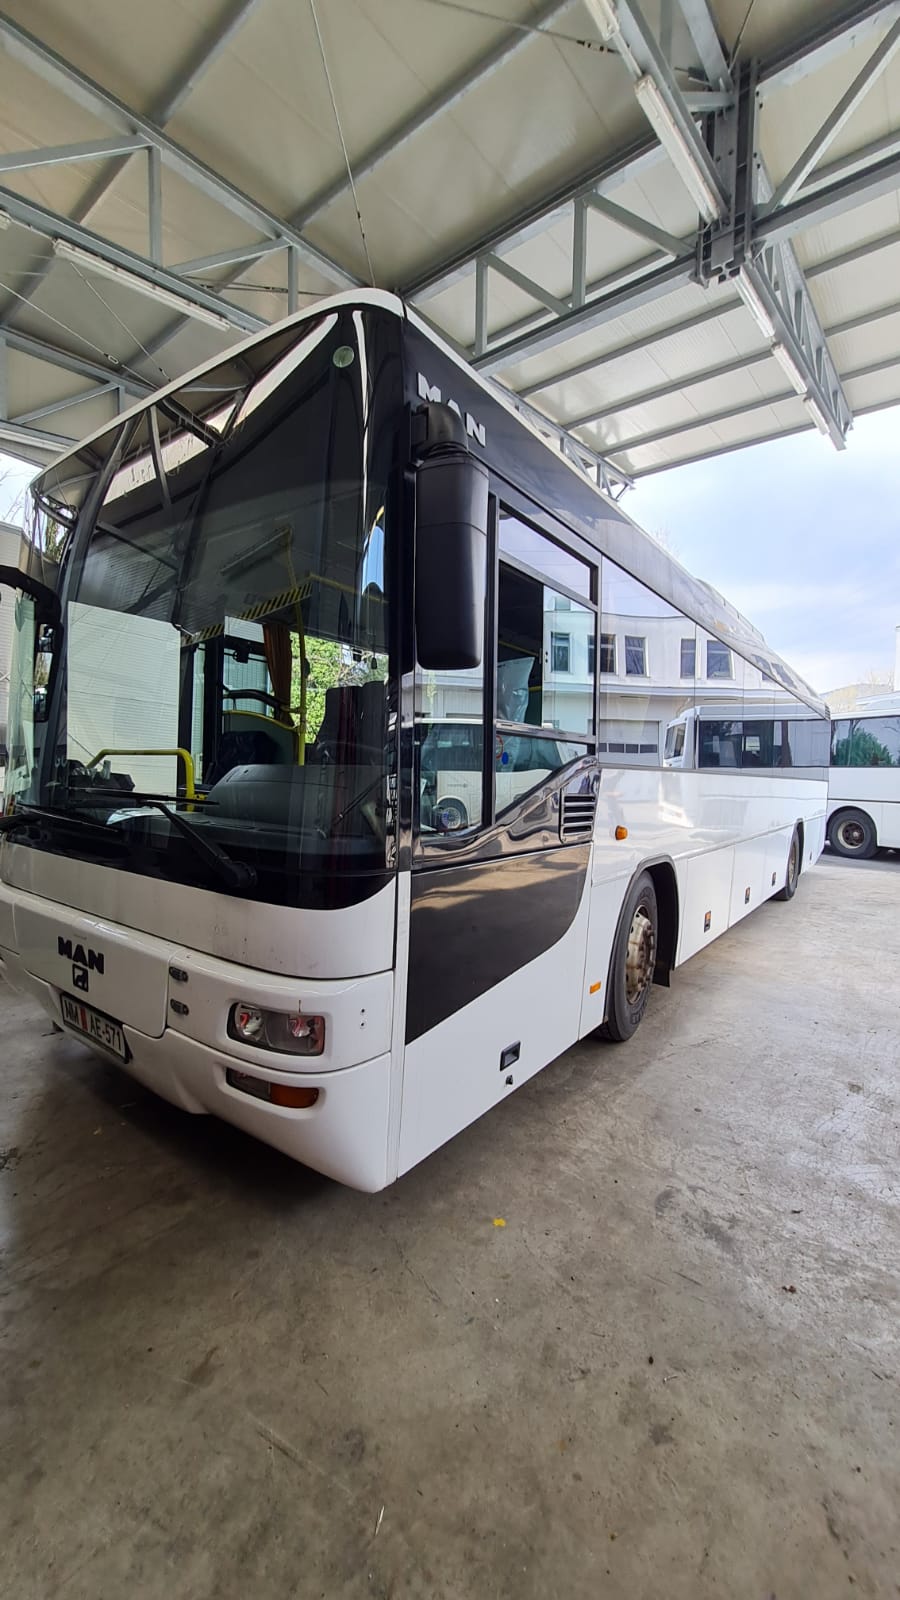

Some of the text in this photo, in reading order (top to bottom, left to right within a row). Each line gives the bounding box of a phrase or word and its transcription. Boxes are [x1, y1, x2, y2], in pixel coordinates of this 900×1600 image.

[416, 371, 486, 448] MN
[58, 936, 104, 975] MAN
[90, 1013, 121, 1051] AE-571
